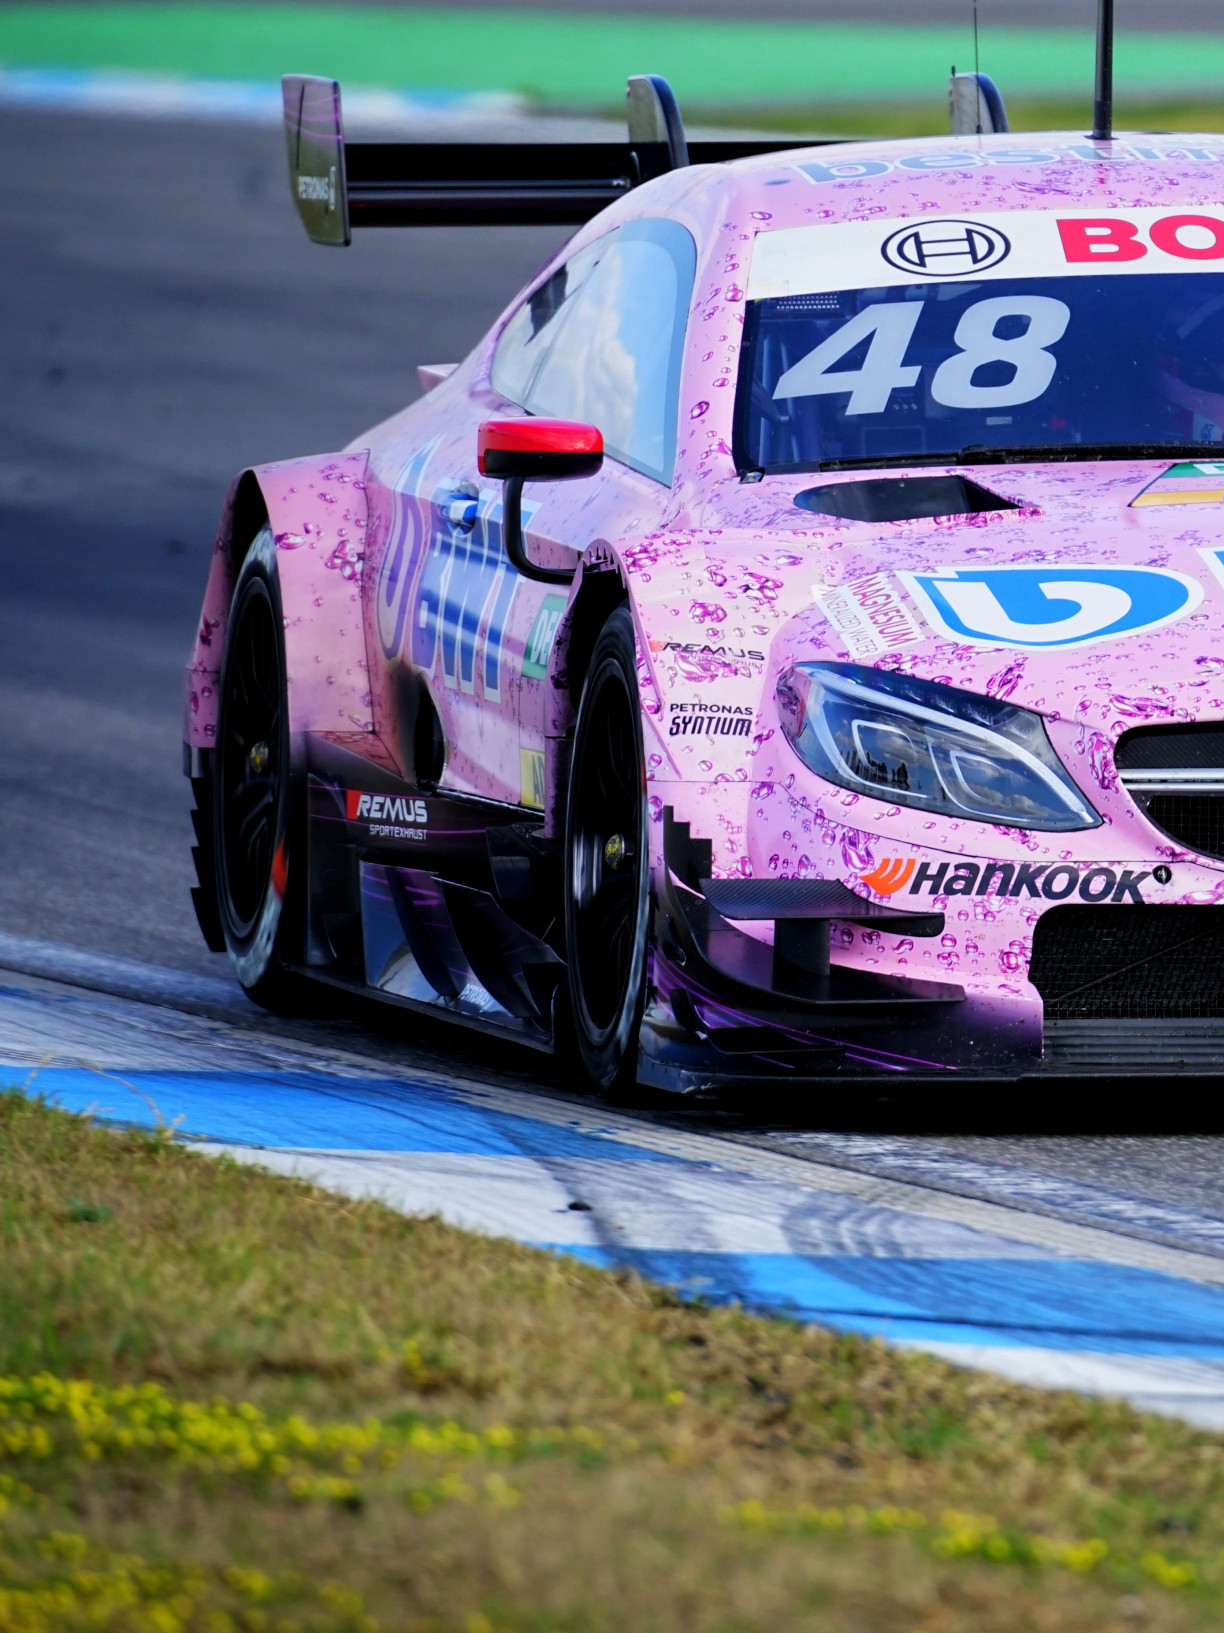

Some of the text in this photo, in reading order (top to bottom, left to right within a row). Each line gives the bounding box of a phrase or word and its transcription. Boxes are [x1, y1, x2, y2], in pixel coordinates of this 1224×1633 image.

[772, 295, 1071, 416] 48
[847, 575, 918, 648] MAGNESIUM
[662, 642, 766, 661] REMUS
[848, 626, 878, 656] WATER
[670, 703, 753, 716] PETRONAS
[669, 715, 753, 737] SYNTIUM
[356, 794, 428, 823] REMUS
[369, 824, 428, 840] SPORTEXHAUST
